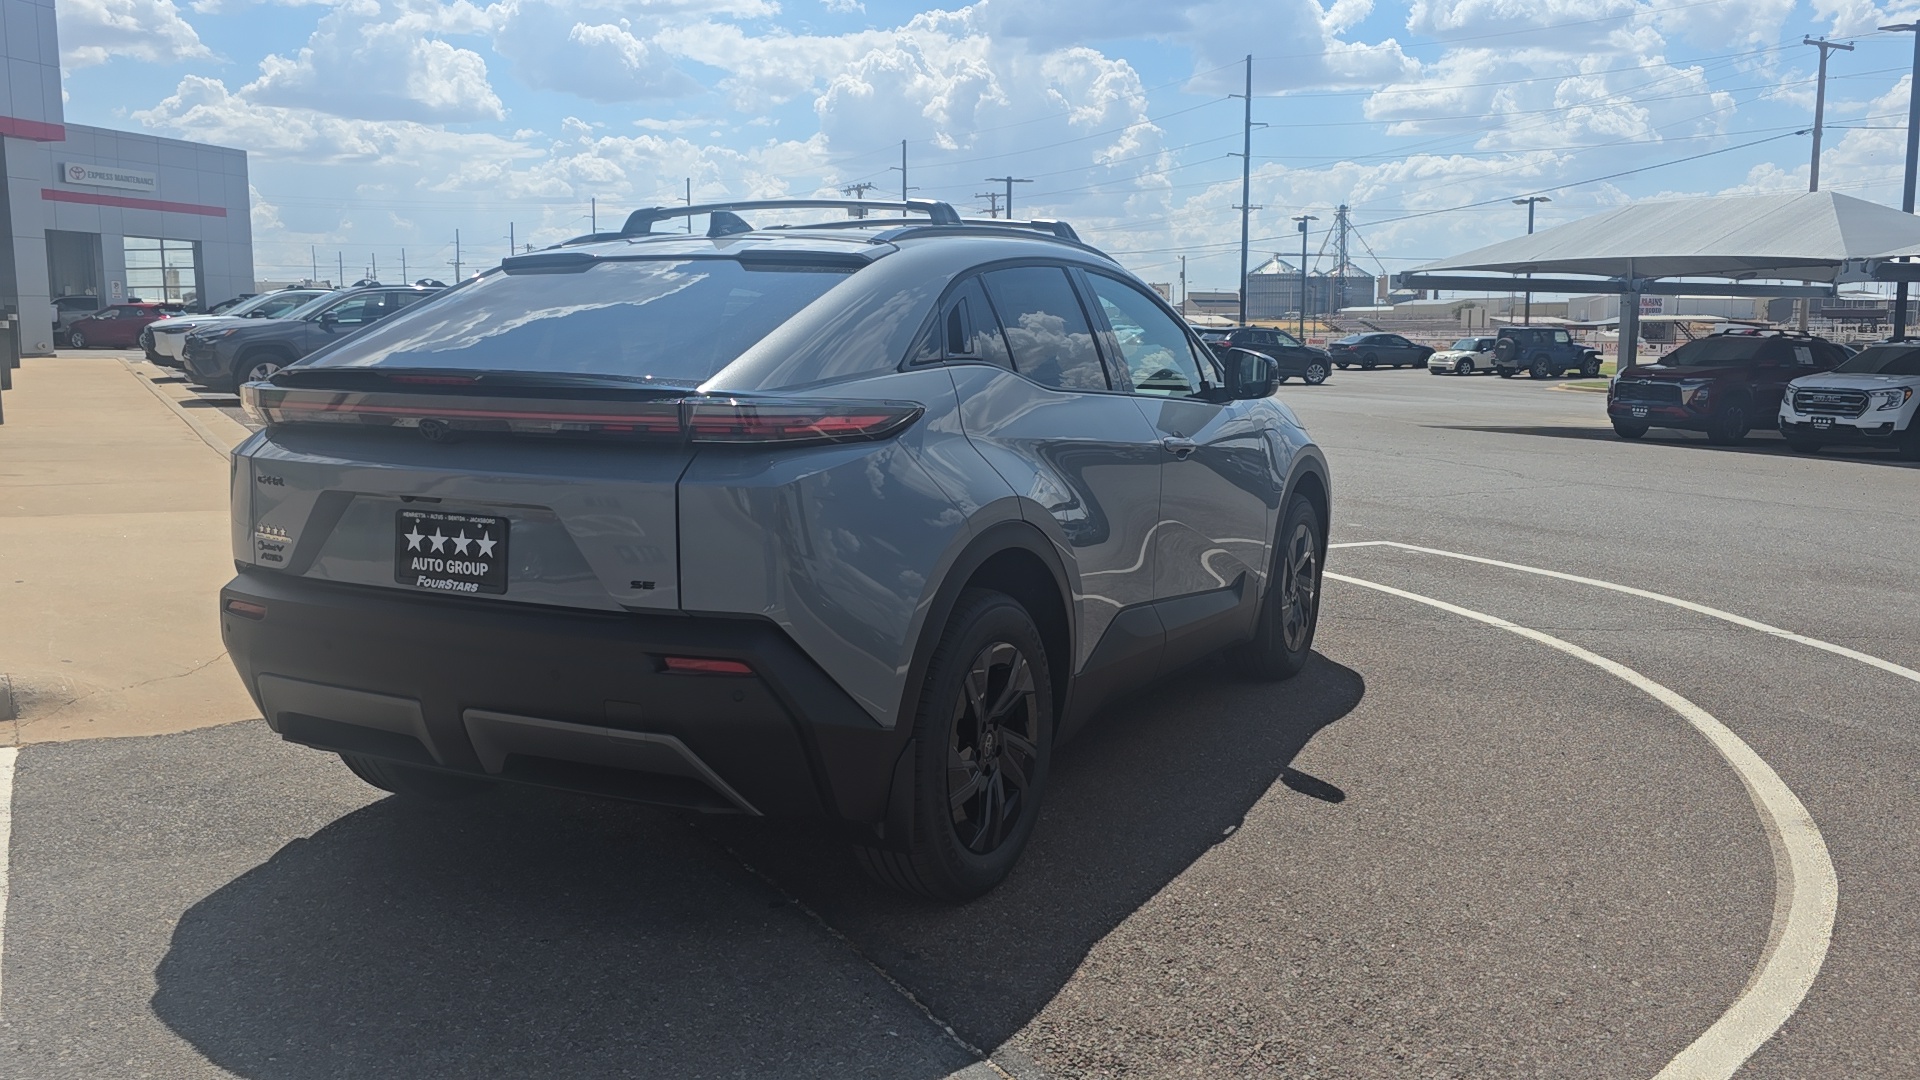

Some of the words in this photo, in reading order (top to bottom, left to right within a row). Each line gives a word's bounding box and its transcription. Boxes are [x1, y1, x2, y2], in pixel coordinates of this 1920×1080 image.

[87, 171, 113, 181] EXPRESS
[114, 174, 154, 187] MAINTENANCE
[402, 511, 426, 519] HENRIETTA
[469, 517, 496, 525] JACKSBORO
[411, 556, 443, 572] AUTO
[446, 559, 489, 576] GROUP
[630, 580, 656, 590] SE
